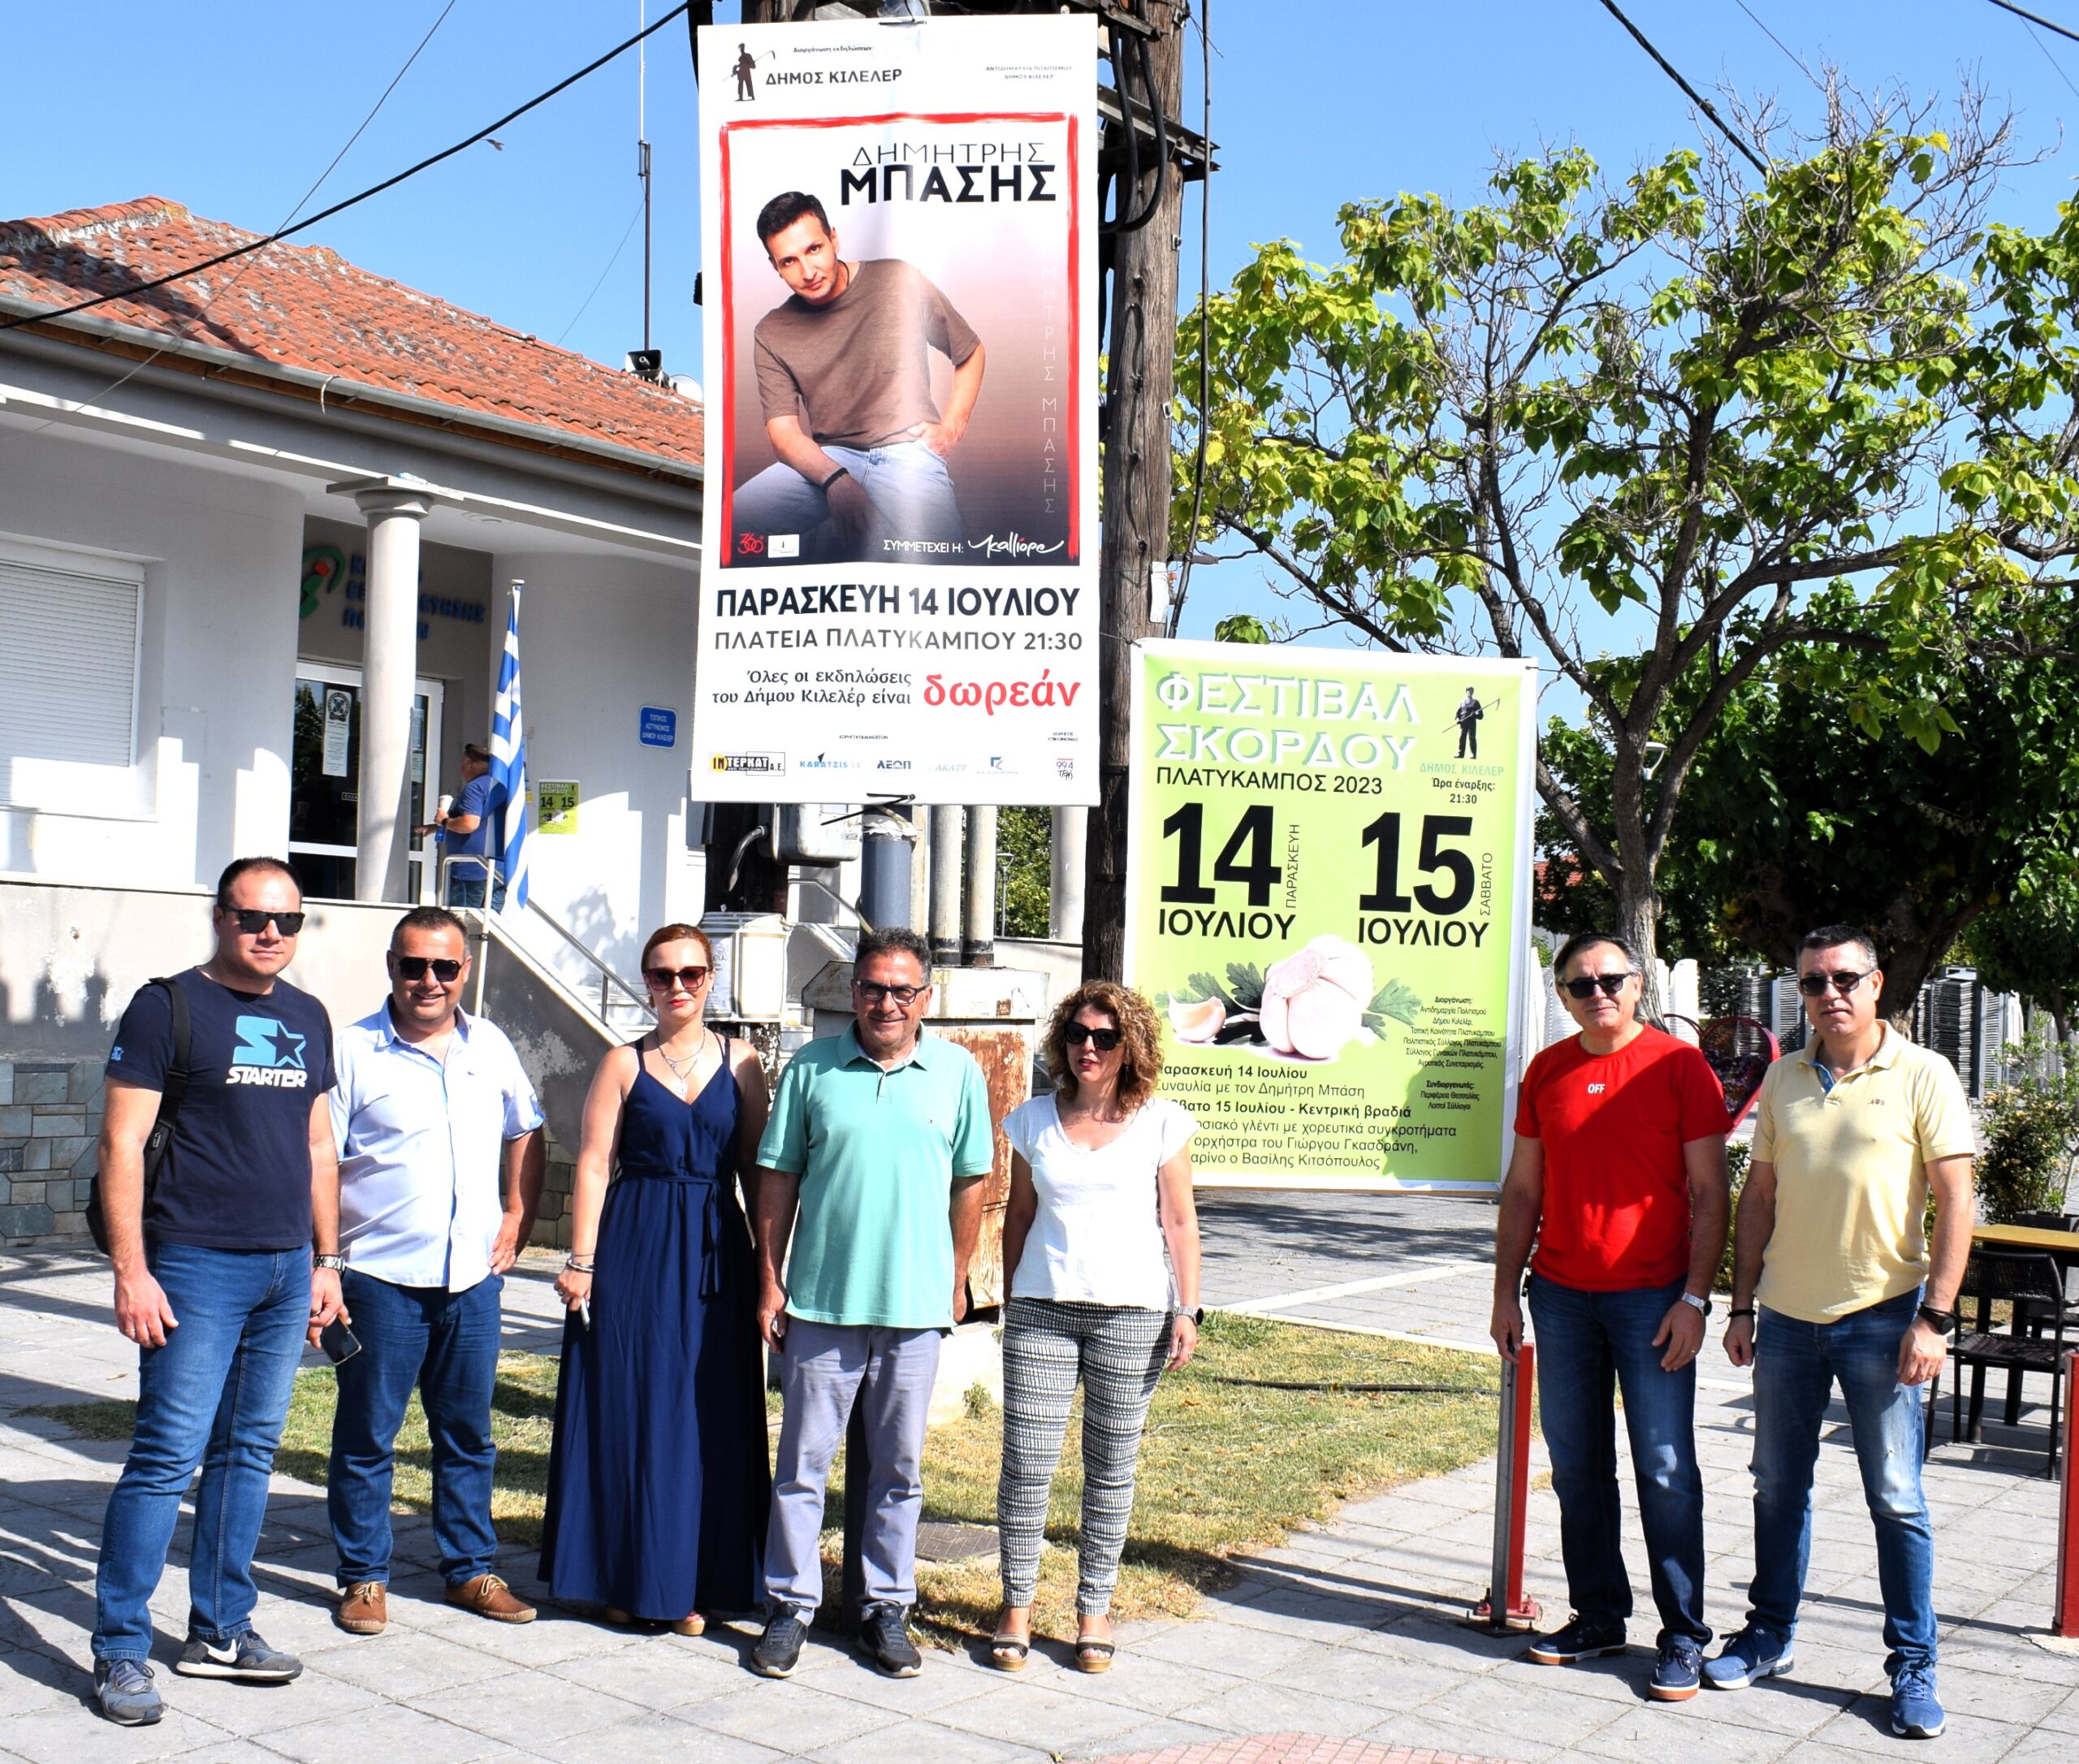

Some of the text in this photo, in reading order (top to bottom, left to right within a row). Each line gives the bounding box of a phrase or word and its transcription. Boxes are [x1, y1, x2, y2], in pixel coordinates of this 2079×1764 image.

[766, 69, 902, 84] ΔΗΜΟΣ ΚΙΛΕΛΕΡ
[853, 143, 1044, 166] ΔΗΜΗΤΡΗΣ
[841, 164, 1056, 205] ΜΠΑΣΗΣ
[884, 539, 949, 553] ΣΥΜΜΕΤΕΧΕΙ
[716, 584, 1080, 616] ΠΑΡΑΣΚΕΥΗ 14 ΙΟΥΛΙΟΥ
[715, 629, 1083, 651] ΠΛΑΤΕΙΑ ΠΛΑΤΥΚΑΜΠΟΥ 21:30
[746, 668, 912, 686] Όλες οι εκδηλώσεις
[712, 687, 911, 707] του Δήμου Κιλελέρ είναι
[923, 668, 1081, 716] δωρεάν
[1156, 672, 1420, 724] ΦΕΣΤΙΒΑΛ
[1155, 724, 1418, 771] ΣΚΟΡΔΟΥ
[1420, 763, 1504, 776] ΔΗΜΟΣ ΚΙΛΕΛΕΡ
[1156, 767, 1382, 794] ΠΛΑΤΥΚΑΜΠΟΣ 2023
[1432, 777, 1495, 792] Ώρα έναρξης:
[540, 796, 575, 808] 14 15
[1450, 793, 1477, 804] 21:30
[1161, 802, 1282, 906] 14
[1359, 812, 1475, 915] 15
[1286, 824, 1300, 908] ΠΑΡΑΣΚΕΥΗ
[1480, 853, 1493, 916] ΣΑΒΒΑΤΟ
[1159, 909, 1296, 940] ΙΟΥΛΙΟΥ
[1359, 917, 1489, 948] ΙΟΥΛΙΟΥ
[1434, 996, 1473, 1005] Διοργάνωση:
[226, 1066, 307, 1087] STARTER
[1159, 1065, 1307, 1079] αρασκευή 14 Ιουλίου
[1216, 1083, 1230, 1095] με
[1235, 1084, 1256, 1093] τον
[1259, 1083, 1314, 1097] Δημήτρη
[1318, 1084, 1365, 1099] Μπάση
[1588, 1083, 1606, 1094] OFF
[1216, 1101, 1231, 1112] 15
[1235, 1101, 1286, 1114] Ιουλίου
[1299, 1103, 1359, 1118] Κεντρική
[1364, 1105, 1411, 1119] βραδιά
[1242, 1120, 1279, 1133] γλέντι
[1283, 1123, 1298, 1134] με
[1302, 1123, 1364, 1135] χορευτικά
[1368, 1124, 1457, 1138] συγκροτήματα
[1194, 1135, 1418, 1154] ορχήστρα του Γιώργου Γκασδράνη,
[1191, 1152, 1381, 1170] αρίνο ο Βασίλης Κιτσόπουλος
